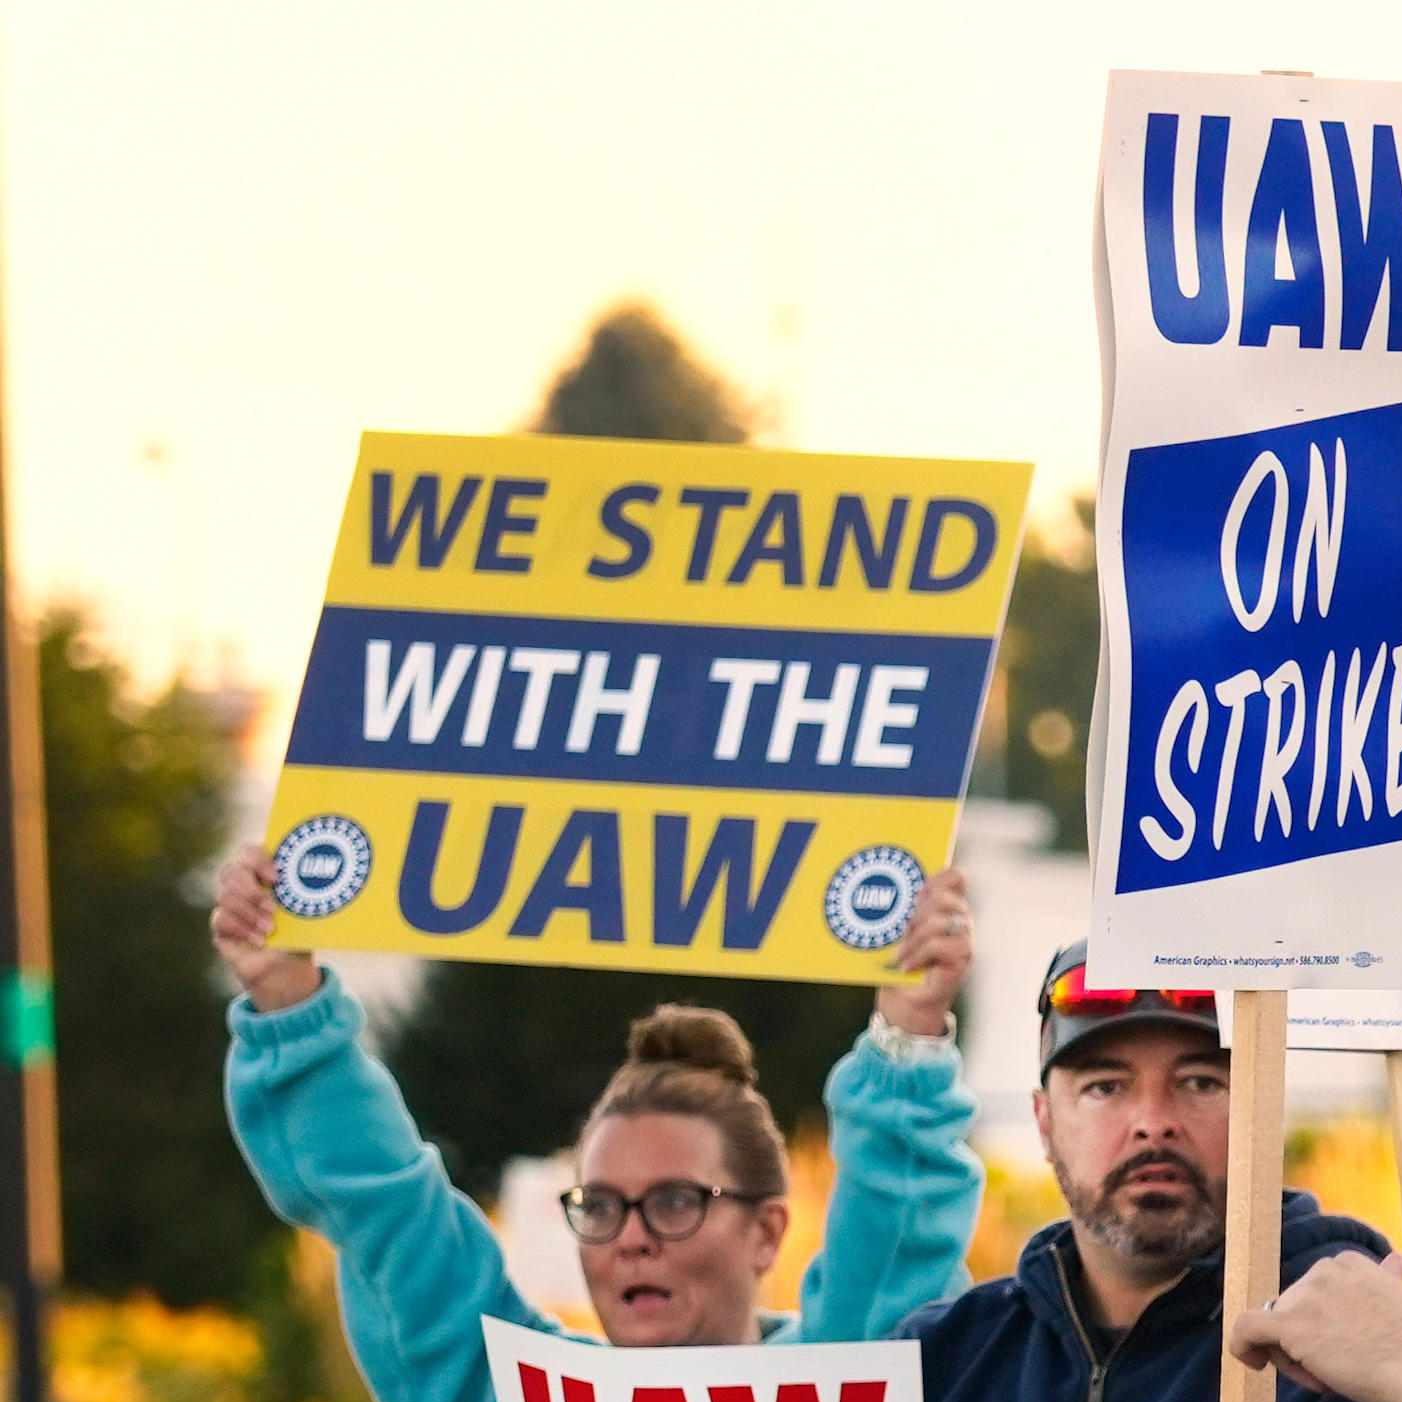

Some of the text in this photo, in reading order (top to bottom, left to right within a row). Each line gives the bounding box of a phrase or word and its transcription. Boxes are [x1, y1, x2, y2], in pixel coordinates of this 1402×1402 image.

[368, 470, 999, 594] WE STAND
[1219, 436, 1348, 633] ON
[363, 640, 930, 769] WITH THE
[302, 853, 342, 879] UAW
[396, 799, 819, 952] UAW
[855, 884, 897, 910] UAW
[1153, 955, 1340, 968] American Graphics whatsyoursign.net 586.790.8500
